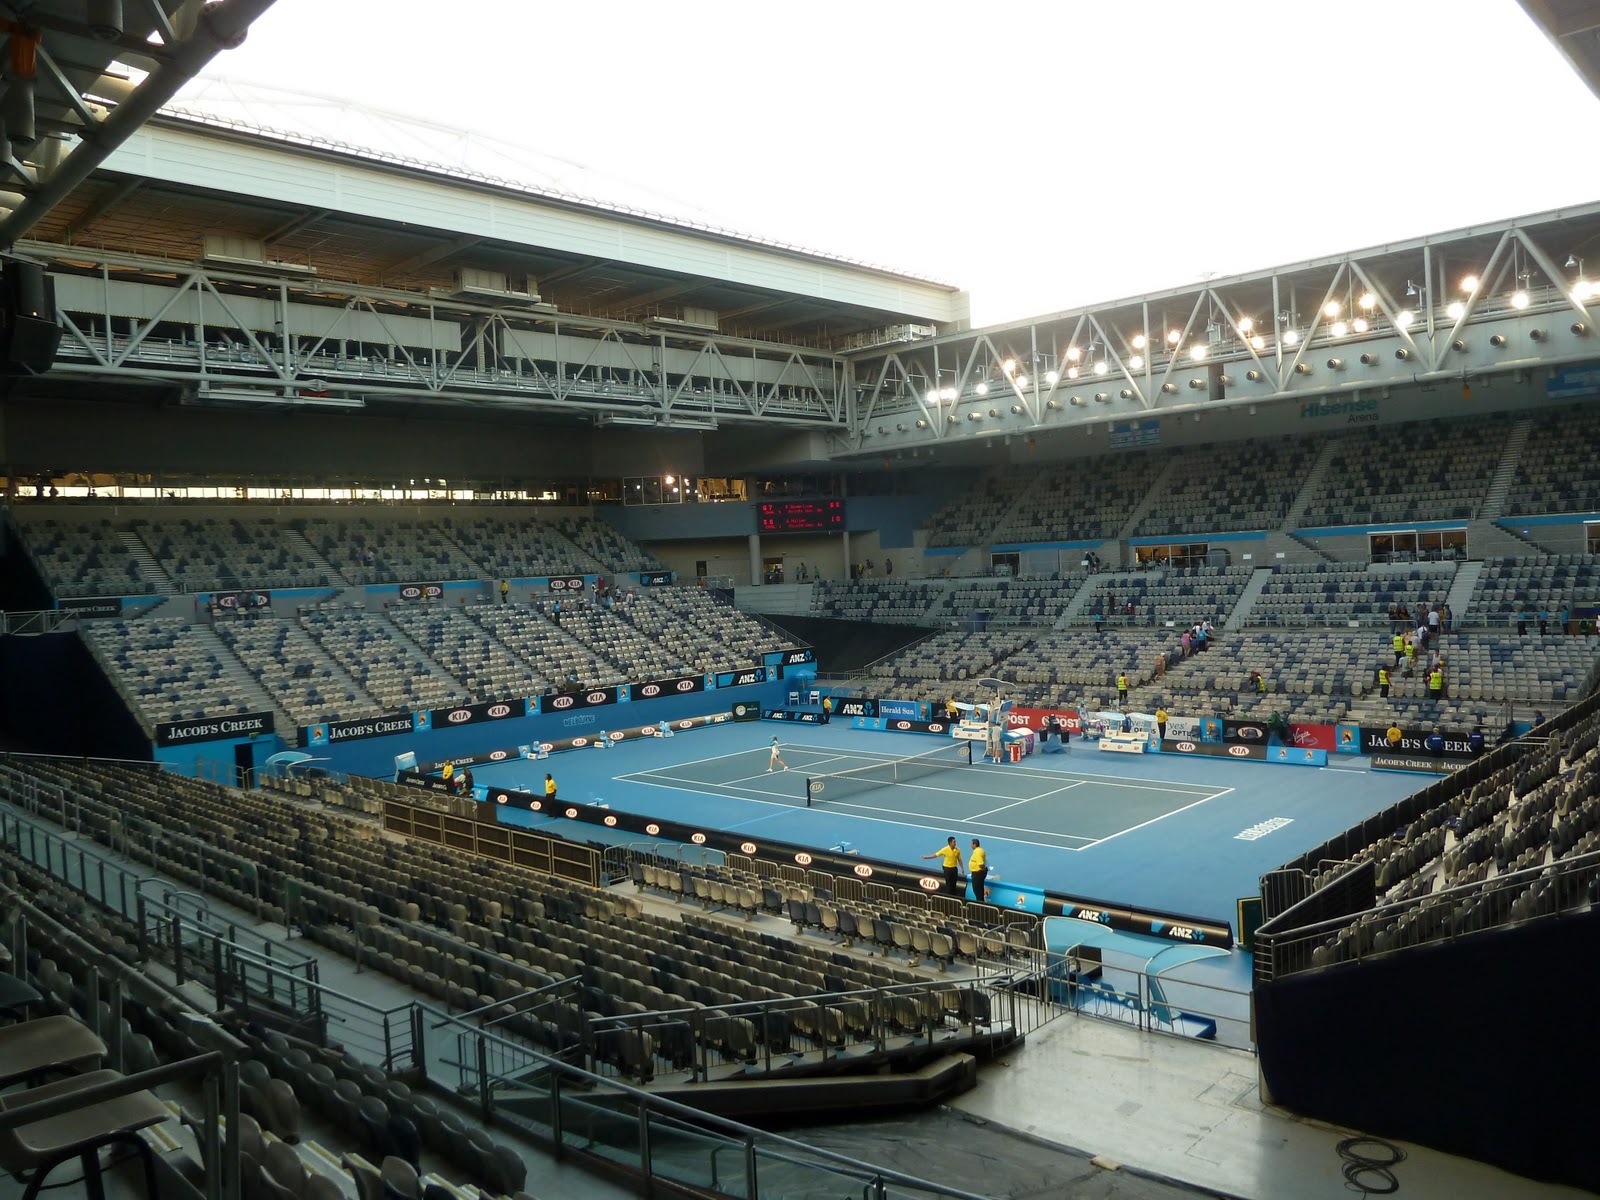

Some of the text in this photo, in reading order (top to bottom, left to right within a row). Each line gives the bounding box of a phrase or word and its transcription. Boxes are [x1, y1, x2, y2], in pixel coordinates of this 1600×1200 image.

[1300, 399, 1377, 418] Hisense
[1347, 412, 1379, 423] Arena
[789, 653, 805, 663] ANZ
[738, 674, 755, 684] ANZ
[842, 704, 864, 715] ANZ
[881, 705, 915, 715] Herald Sun
[167, 718, 263, 740] JACOB'S CREEK
[329, 718, 412, 741] JACOB'S CREEK
[1368, 734, 1421, 749] JACB'S
[1374, 757, 1432, 769] JACOB'S CREEK
[1078, 909, 1100, 922] ANZ
[1169, 926, 1193, 939] ANZ
